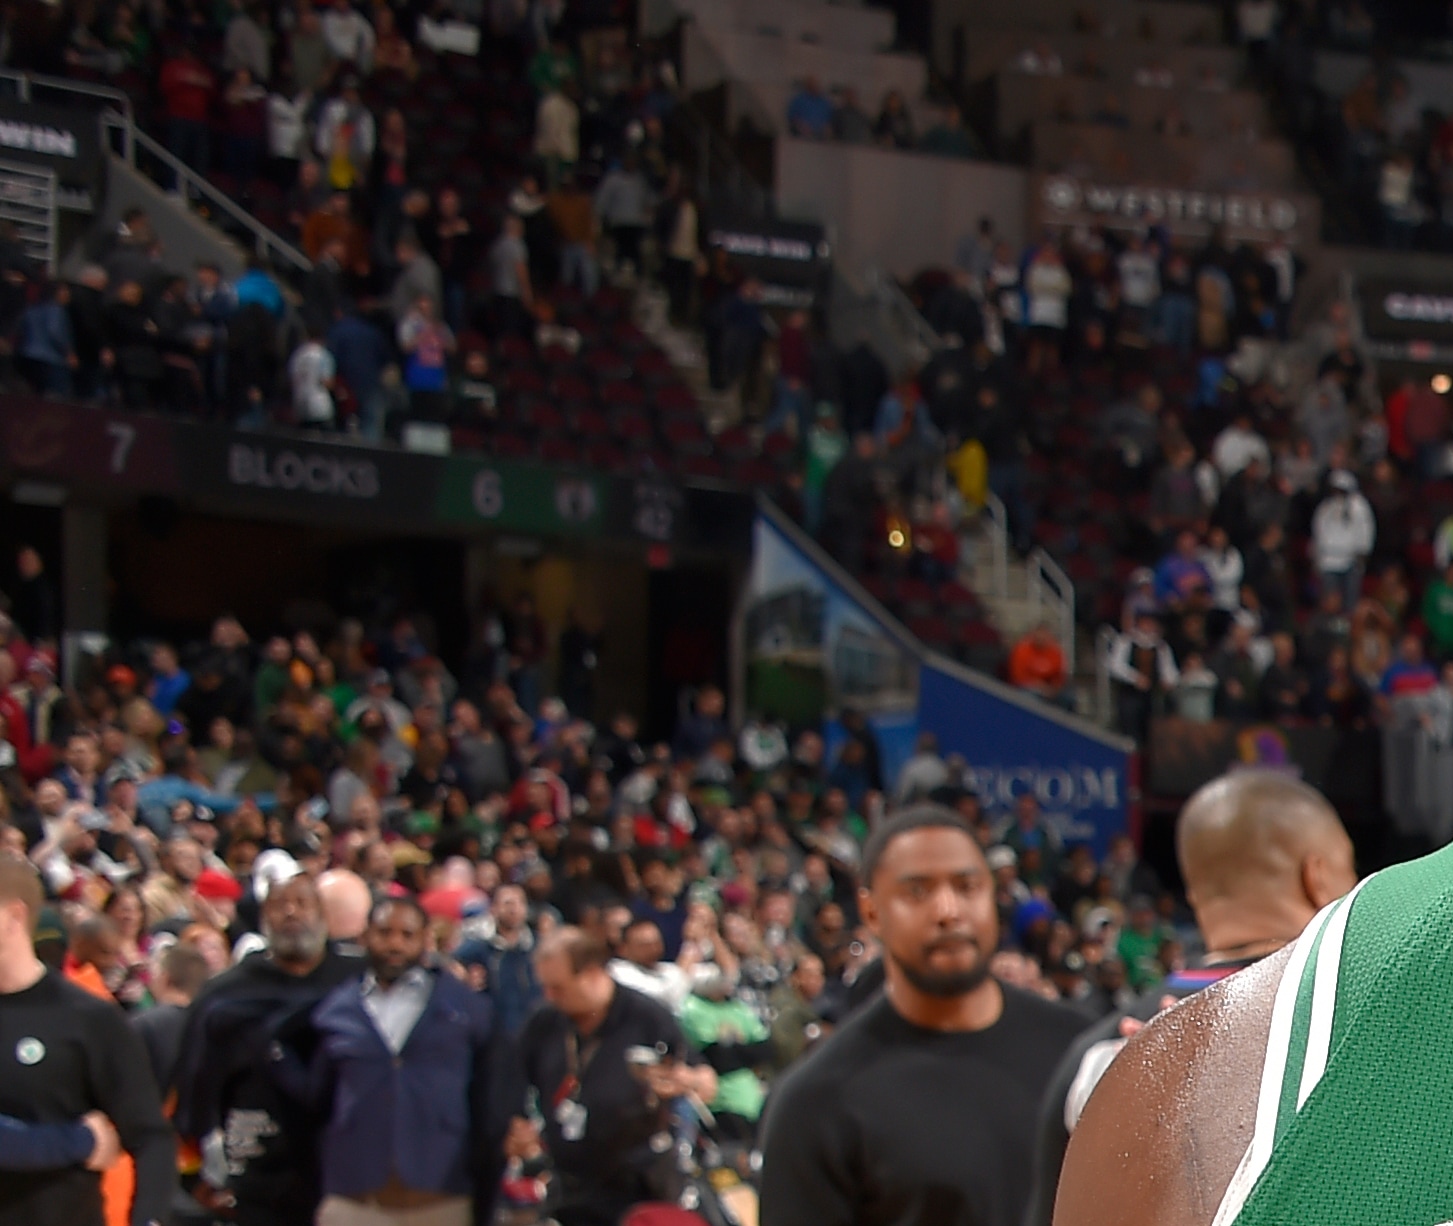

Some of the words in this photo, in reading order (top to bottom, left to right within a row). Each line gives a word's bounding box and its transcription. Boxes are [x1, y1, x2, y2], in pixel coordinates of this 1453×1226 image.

[1085, 185, 1297, 231] WESTFIELD
[106, 421, 137, 475] 7
[228, 443, 380, 499] BLOCKS
[471, 469, 504, 519] 6
